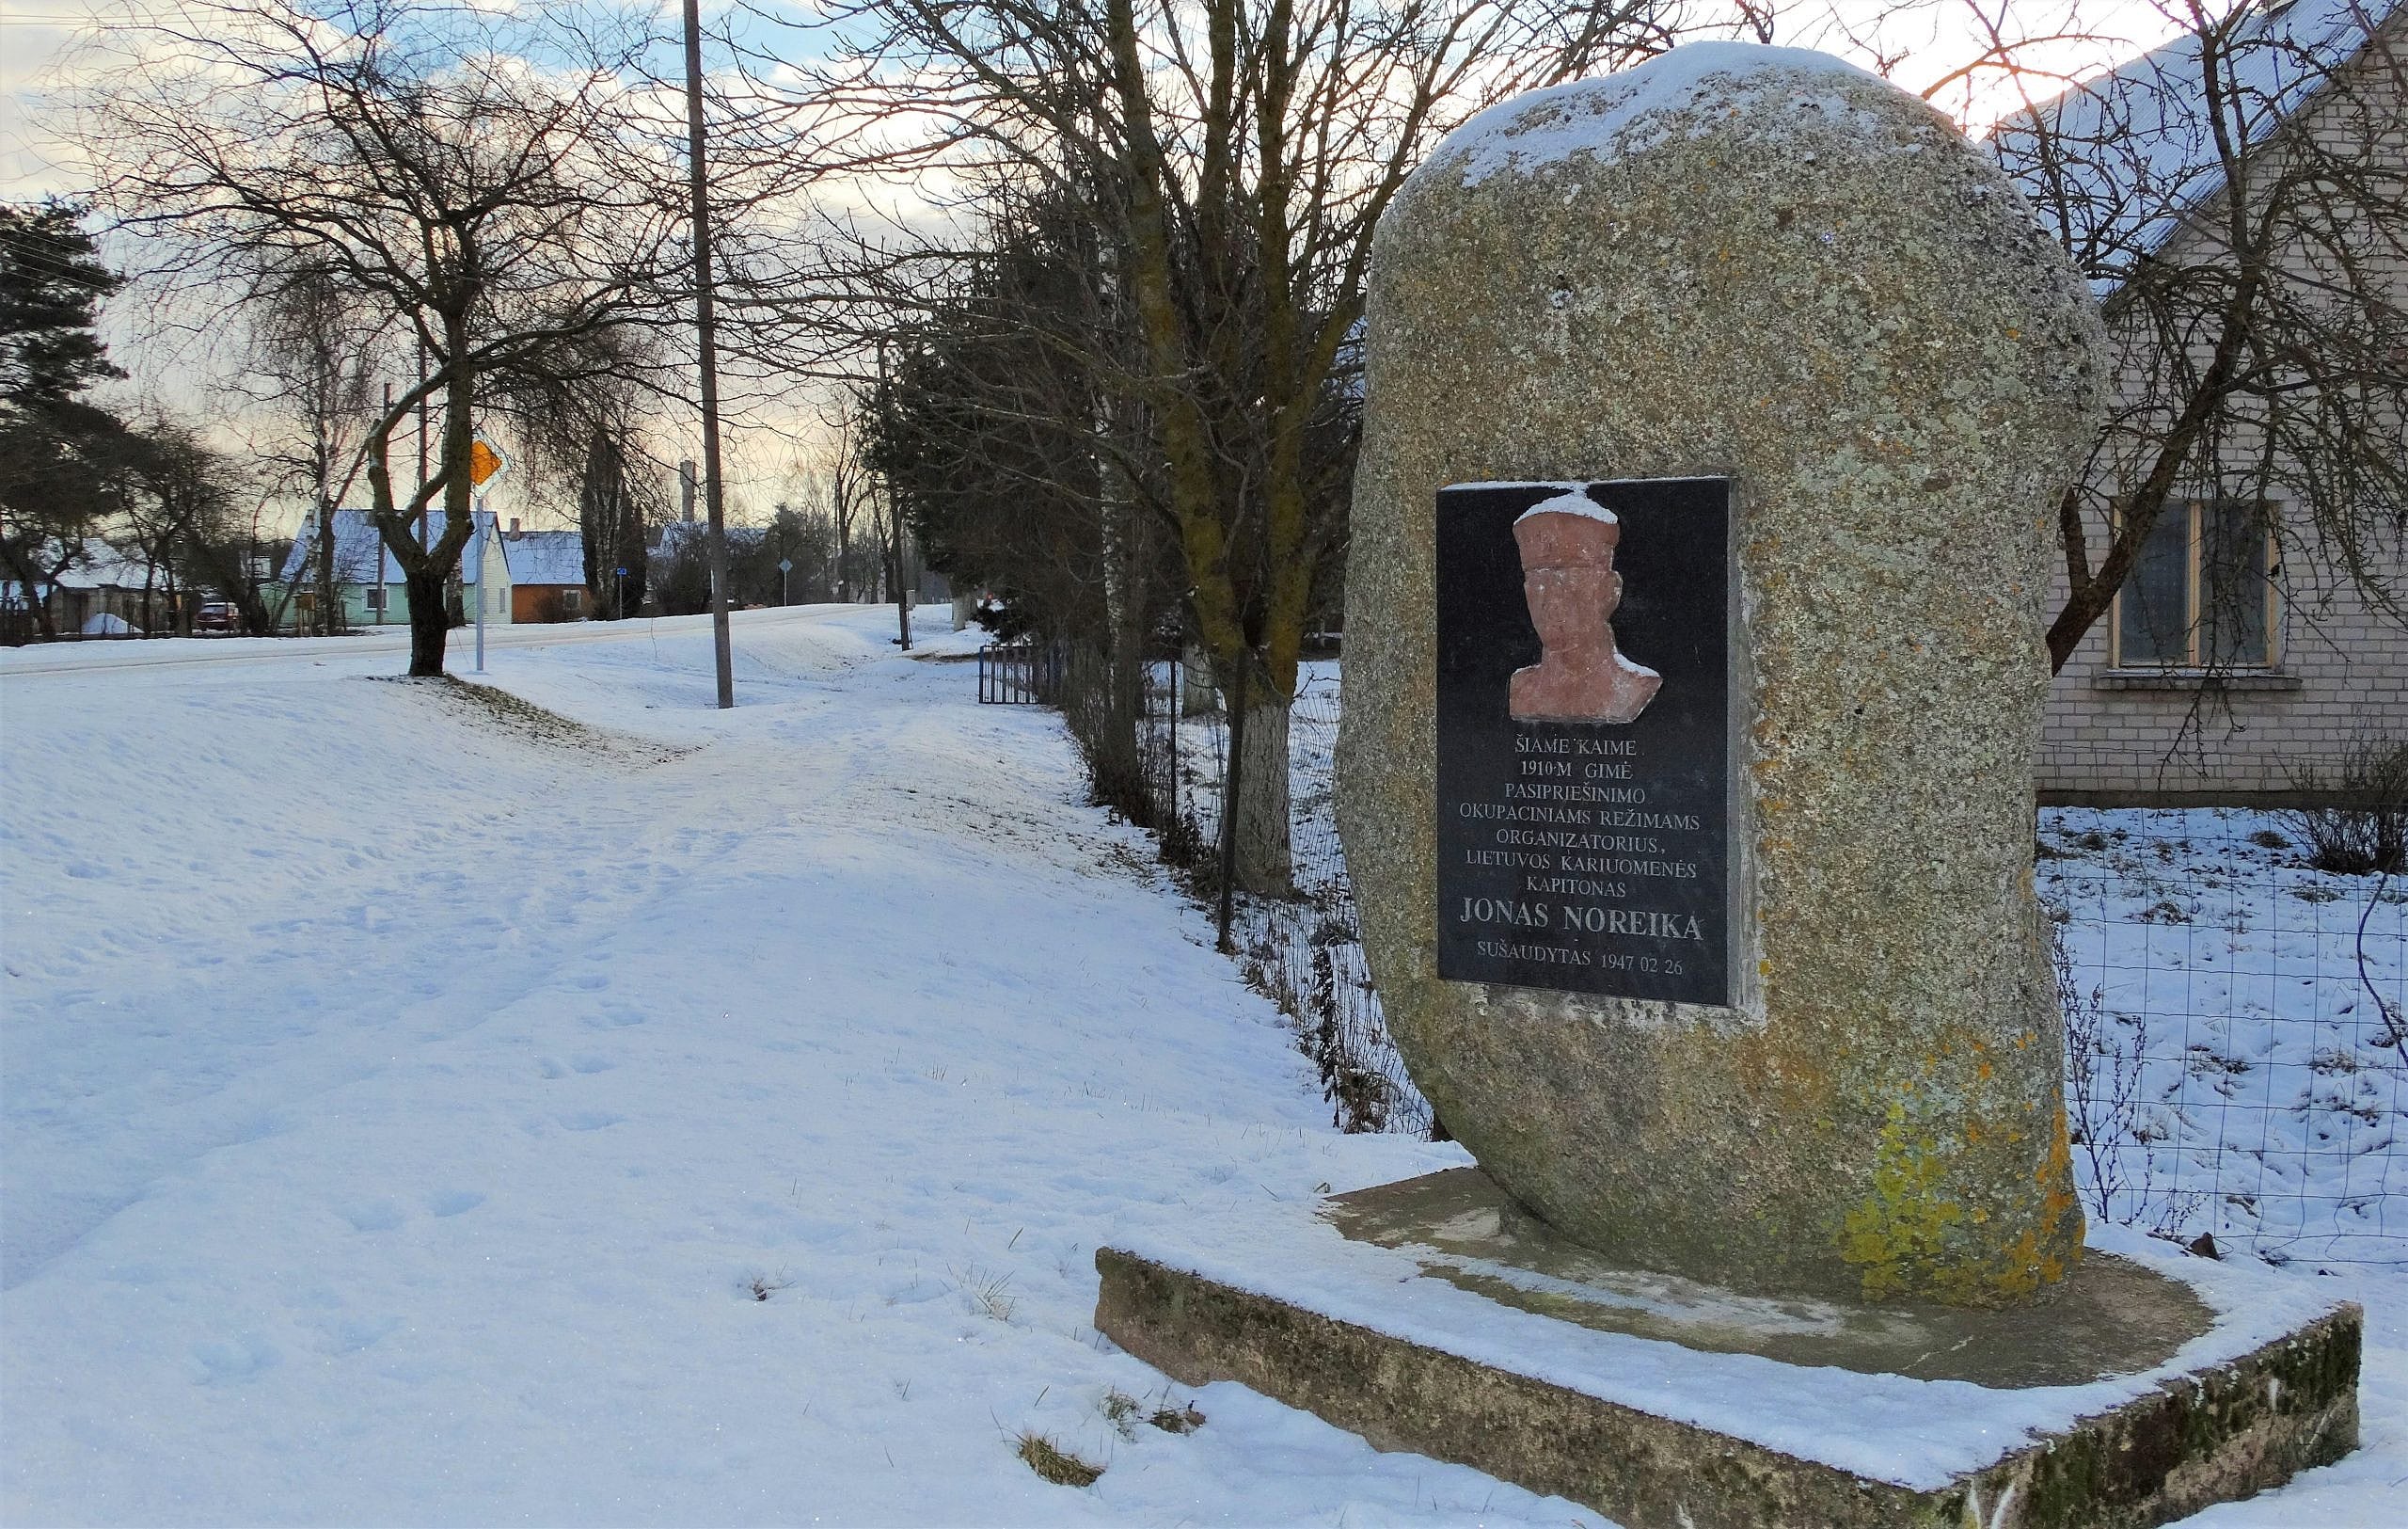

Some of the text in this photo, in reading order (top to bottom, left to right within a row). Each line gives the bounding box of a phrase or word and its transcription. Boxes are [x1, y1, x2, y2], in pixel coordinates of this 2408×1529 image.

[1514, 734, 1637, 756] ŠIAME KAIME
[1585, 762, 1633, 779] GIMĖ
[1505, 781, 1645, 804] PASIPRIEŠINIMO
[1460, 803, 1700, 830] OKUPACINIAMS REŽIMAMS
[1497, 829, 1665, 853] ORGANIZATORIUS,
[1466, 850, 1697, 878] LIETUVOS KARIUOMENĖS
[1527, 877, 1626, 897] KAPITONAS
[1460, 898, 1703, 940] JONAS NOREIKA
[1478, 939, 1682, 974] SUŠAUDYTAS 1947 02 26
